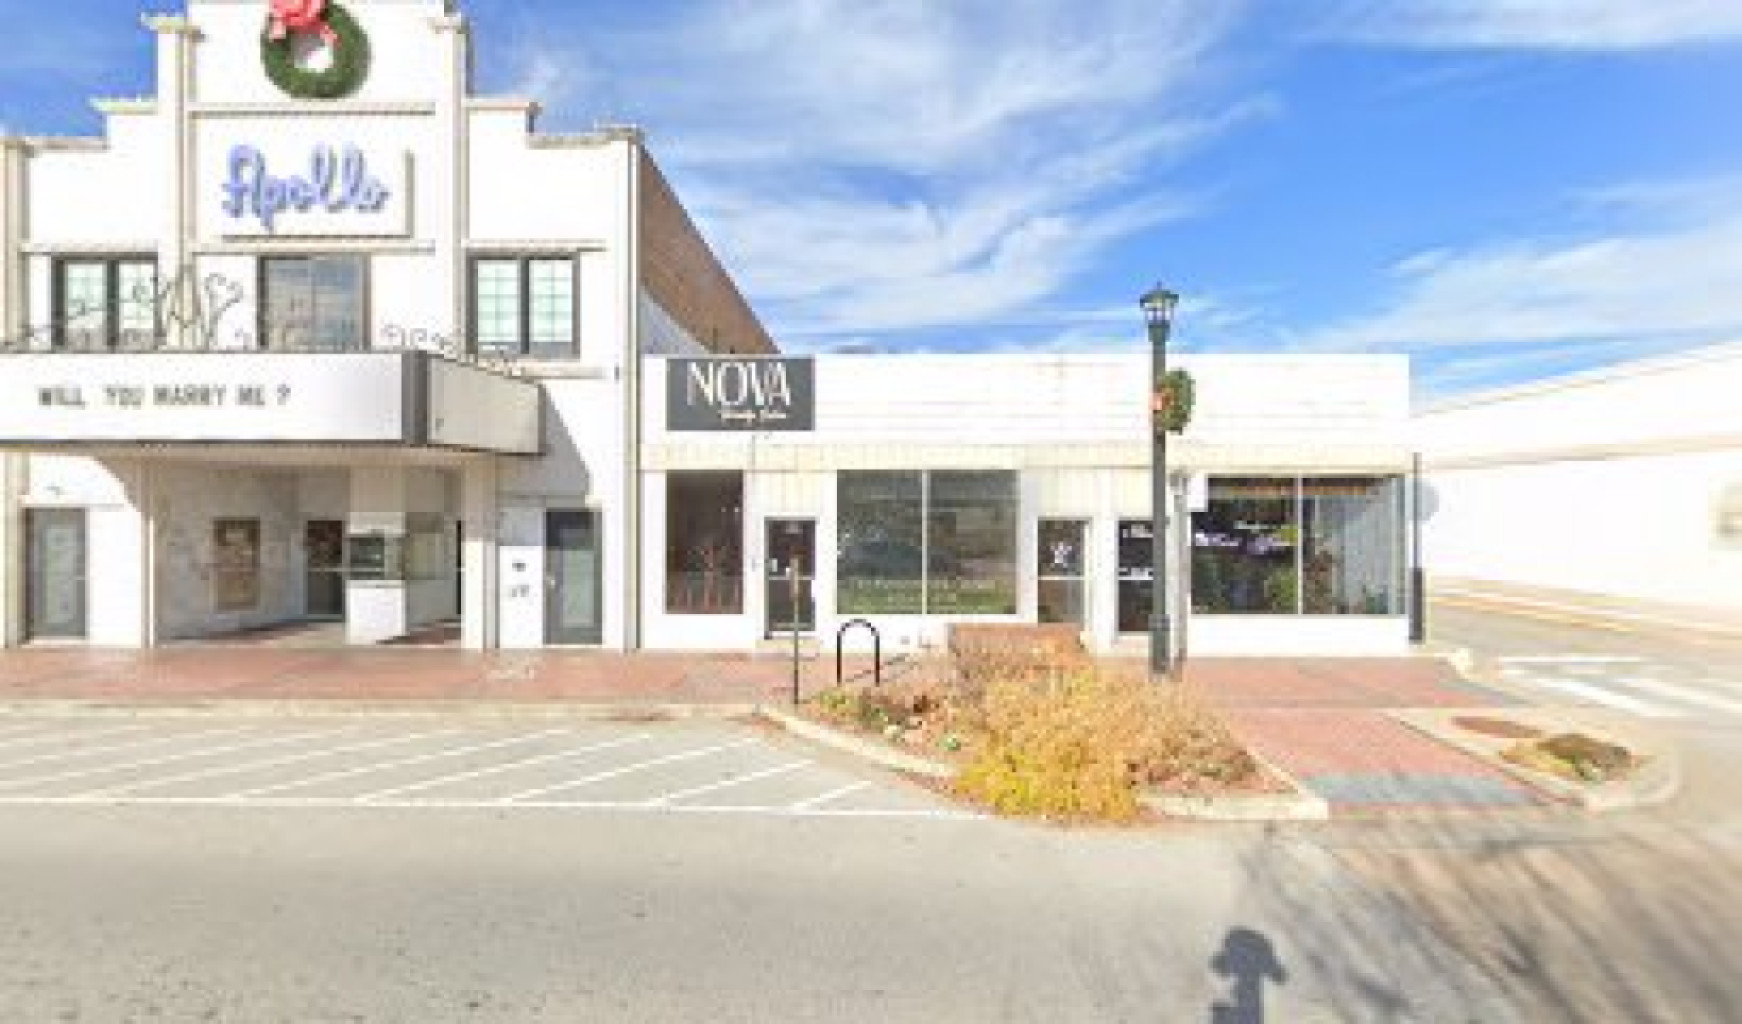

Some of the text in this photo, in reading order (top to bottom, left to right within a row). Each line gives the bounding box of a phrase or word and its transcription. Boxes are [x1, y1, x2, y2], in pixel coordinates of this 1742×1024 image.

[221, 143, 390, 231] Apollo
[38, 386, 86, 407] WILL
[105, 386, 143, 407] YOU
[153, 386, 227, 407] MARRY
[236, 386, 266, 407] ME
[687, 361, 791, 406] NOVA
